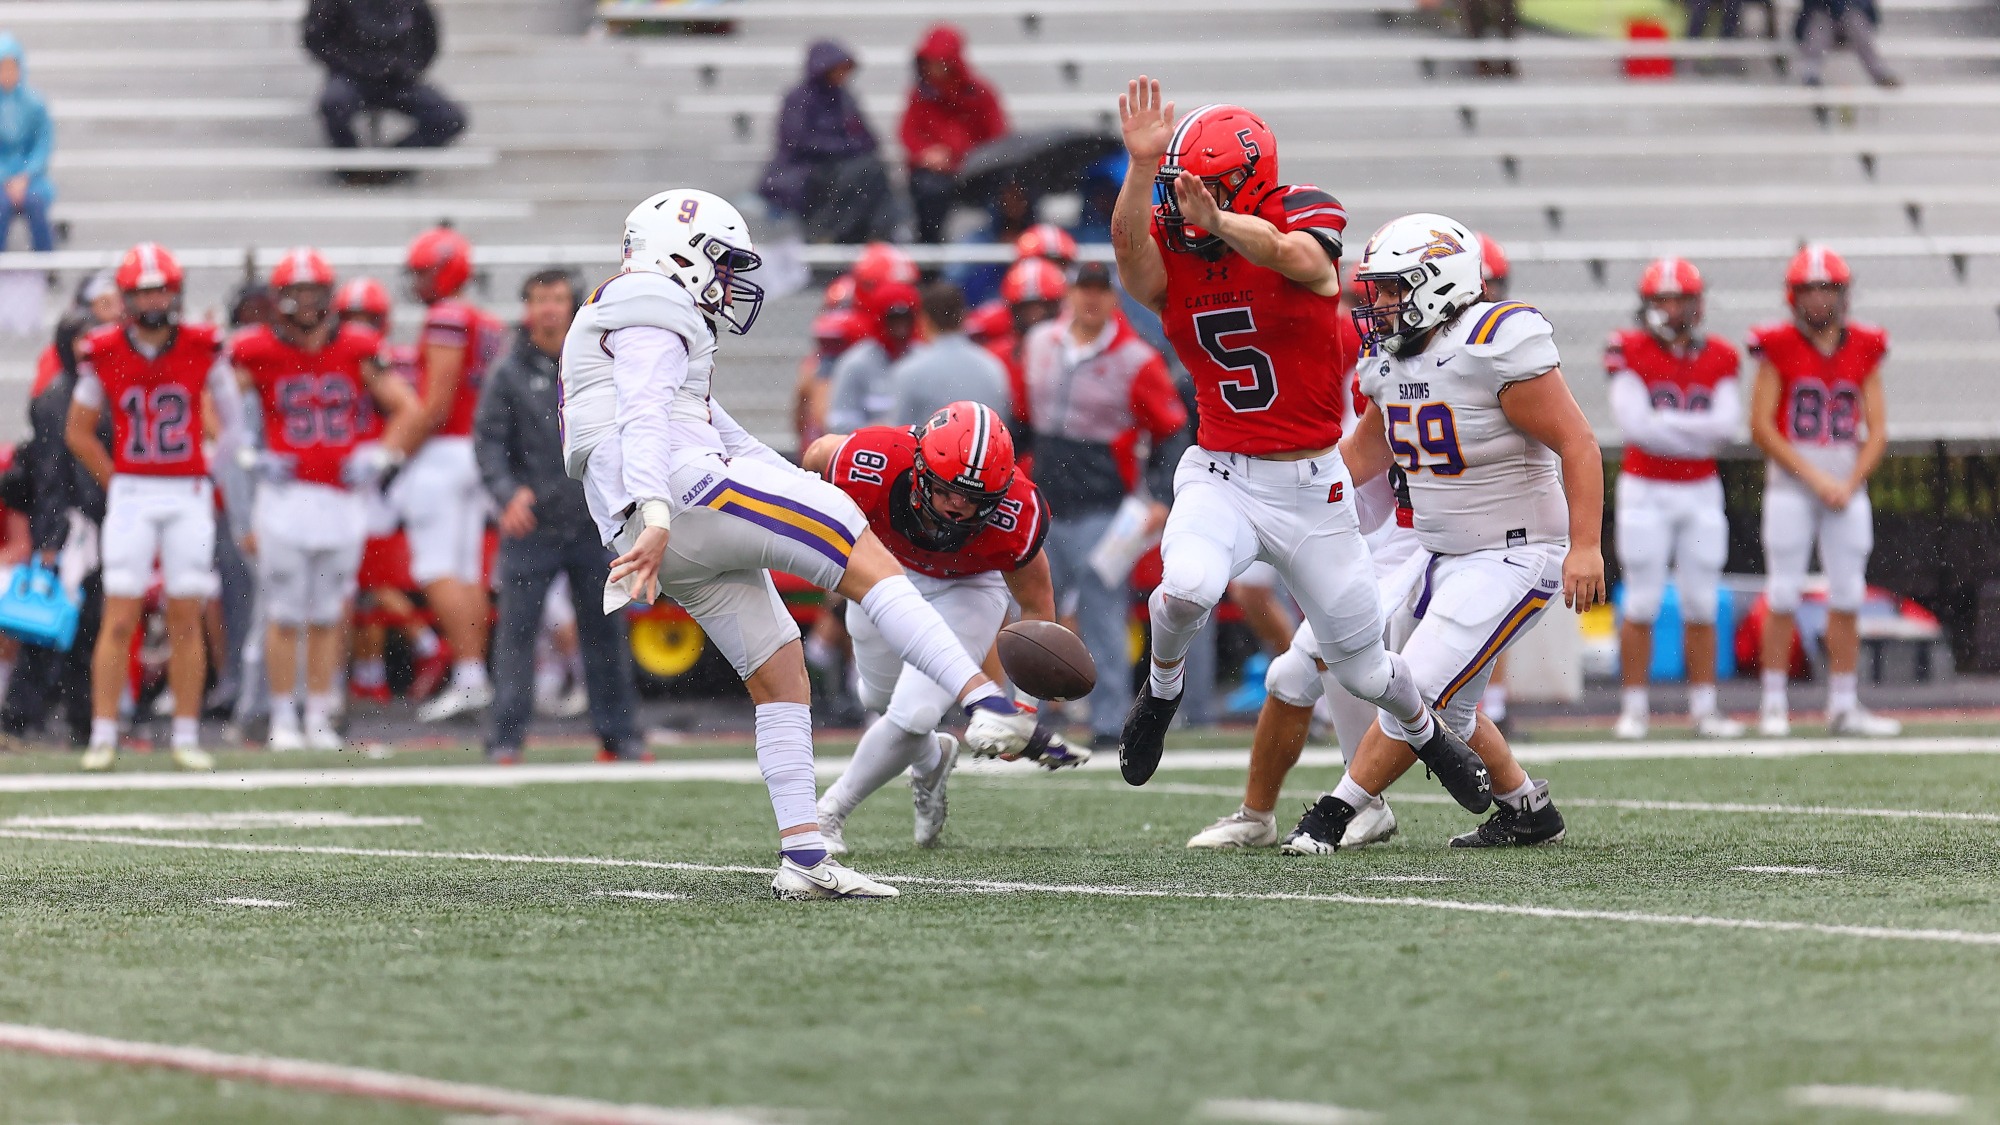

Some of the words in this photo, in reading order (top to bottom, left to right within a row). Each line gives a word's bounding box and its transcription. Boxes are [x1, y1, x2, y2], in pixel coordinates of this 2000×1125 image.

[677, 199, 699, 224] 9
[1185, 289, 1254, 309] CATHOLIC
[1192, 306, 1279, 413] 5
[1399, 382, 1430, 400] SAXONS
[119, 384, 193, 464] 12
[1386, 401, 1469, 478] 59
[848, 448, 889, 486] 81
[681, 473, 714, 505] SAXONS
[1327, 481, 1343, 503] C
[1511, 530, 1522, 538] XL
